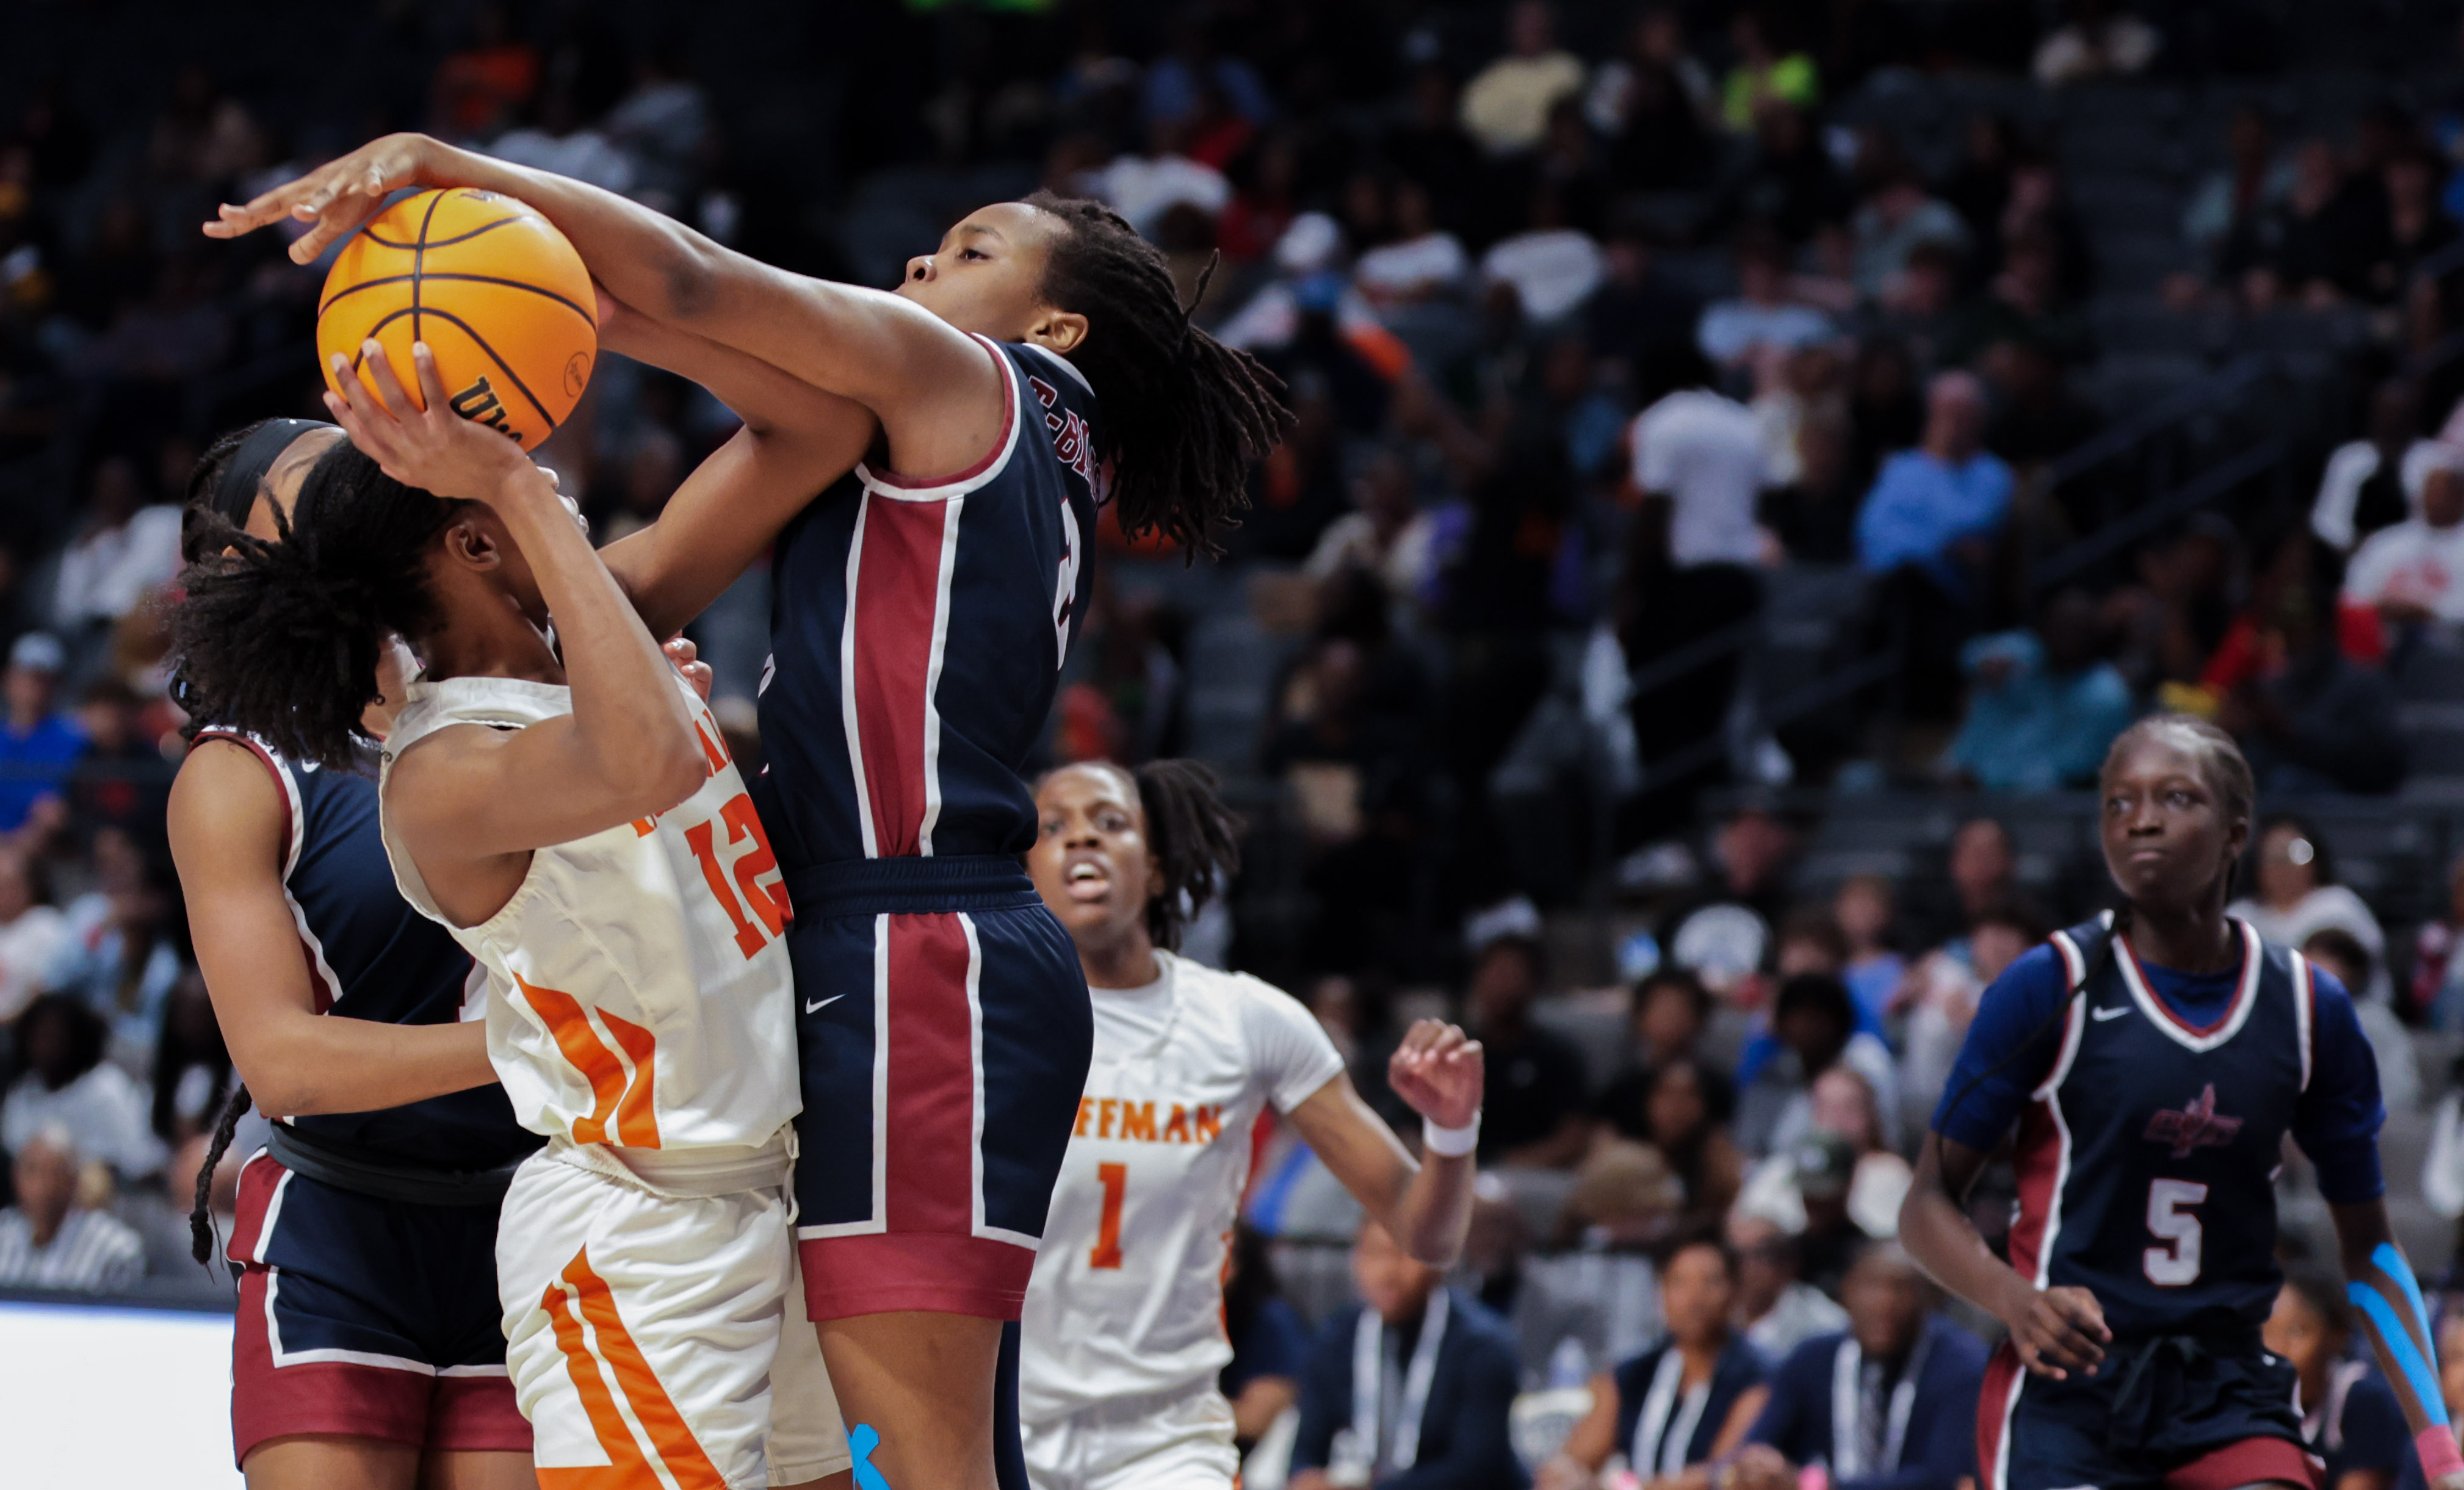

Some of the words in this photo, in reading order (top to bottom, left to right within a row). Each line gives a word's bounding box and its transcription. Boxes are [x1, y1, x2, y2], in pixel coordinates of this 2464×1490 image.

[684, 792, 794, 960] 12
[1074, 1096, 1224, 1144] FFMAN
[1090, 1162, 1126, 1269] 1
[2142, 1178, 2208, 1287] 5
